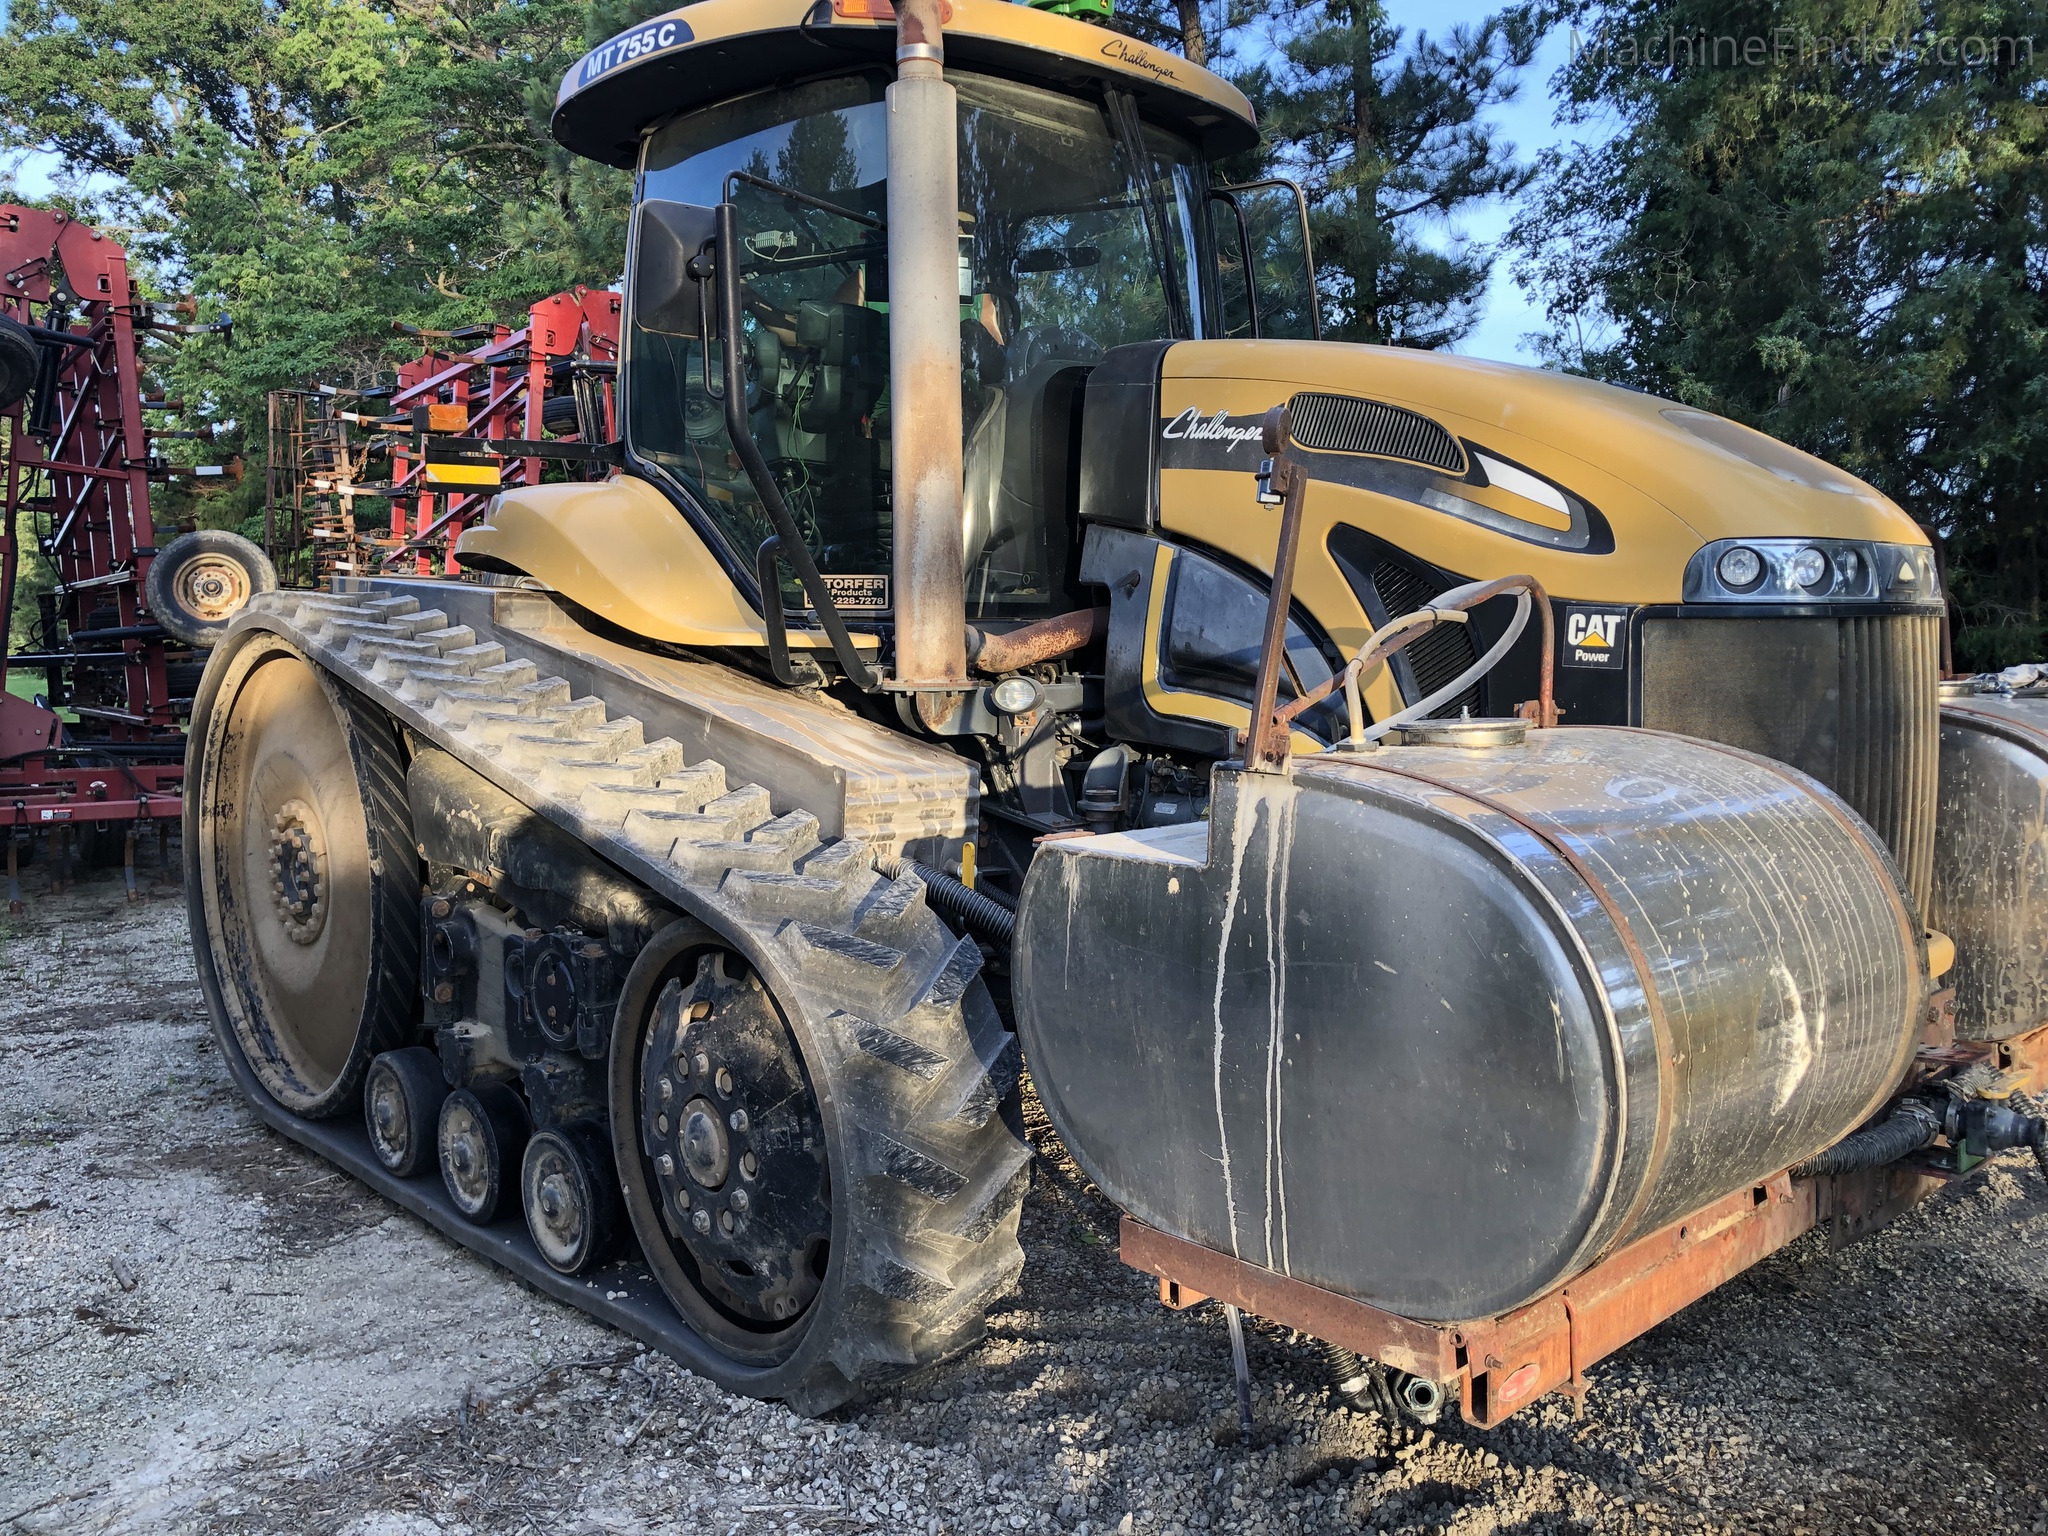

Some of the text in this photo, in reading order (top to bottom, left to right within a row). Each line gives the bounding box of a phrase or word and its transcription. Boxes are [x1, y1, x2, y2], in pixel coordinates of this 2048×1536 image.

[1100, 39, 1185, 83] Challenger
[1162, 405, 1264, 453] Challenger
[824, 578, 884, 589] TORFER
[1567, 613, 1622, 648] CAT
[1574, 649, 1610, 663] Power
